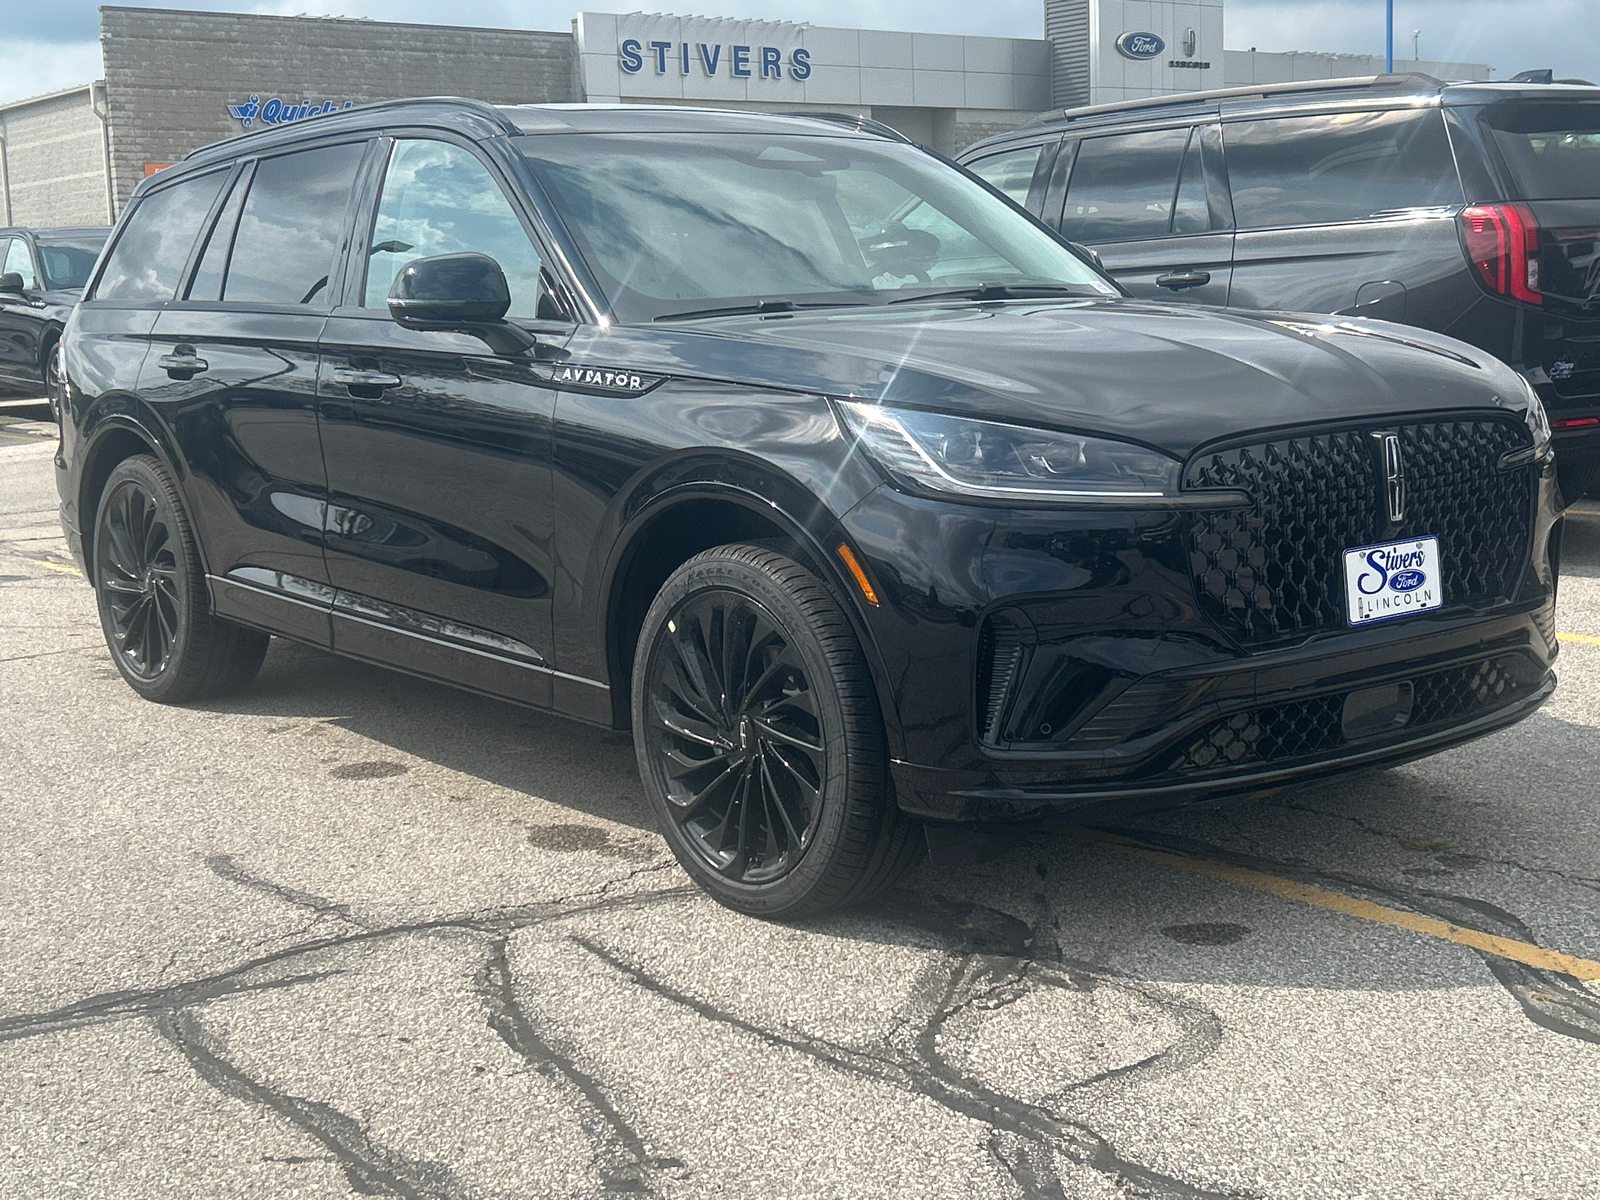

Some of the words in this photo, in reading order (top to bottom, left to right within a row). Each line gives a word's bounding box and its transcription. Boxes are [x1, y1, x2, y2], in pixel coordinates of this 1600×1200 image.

[1131, 36, 1157, 53] Ford
[621, 39, 811, 80] STIVERS
[261, 98, 339, 125] Quick
[562, 368, 642, 389] AVIATOR
[1357, 547, 1425, 595] Stivers
[1396, 573, 1418, 588] Ford
[1368, 590, 1432, 612] LINCOLN
